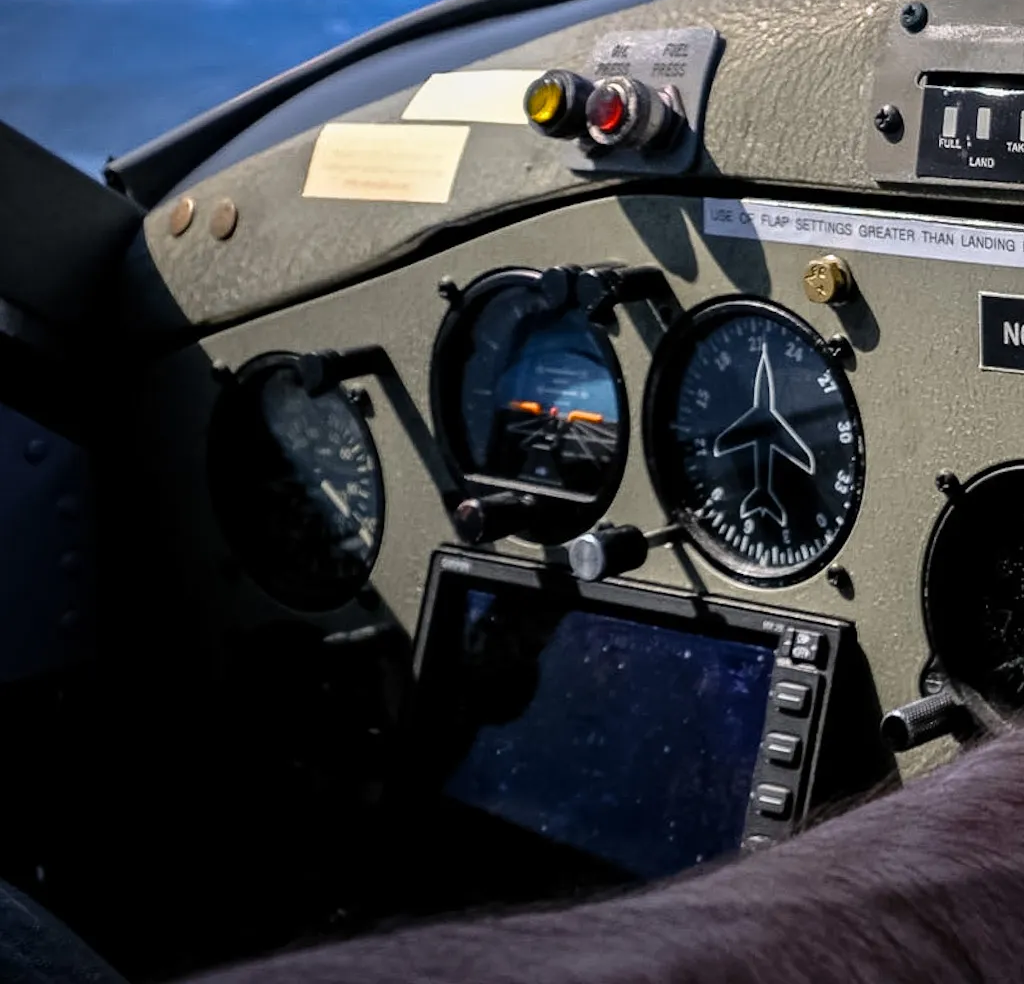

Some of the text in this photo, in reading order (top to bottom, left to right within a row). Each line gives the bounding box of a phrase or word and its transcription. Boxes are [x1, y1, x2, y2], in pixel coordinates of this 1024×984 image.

[938, 137, 962, 150] FULL
[969, 156, 995, 168] LAND
[711, 208, 733, 223] USE
[738, 210, 754, 225] OF
[761, 214, 789, 229] FLAP
[795, 219, 852, 236] SETTINGS
[859, 224, 915, 242] GREATER
[922, 230, 954, 245] THAN
[961, 234, 1015, 252] LANDING
[816, 368, 839, 394] 27
[835, 420, 854, 445] 30
[834, 469, 853, 495] 33
